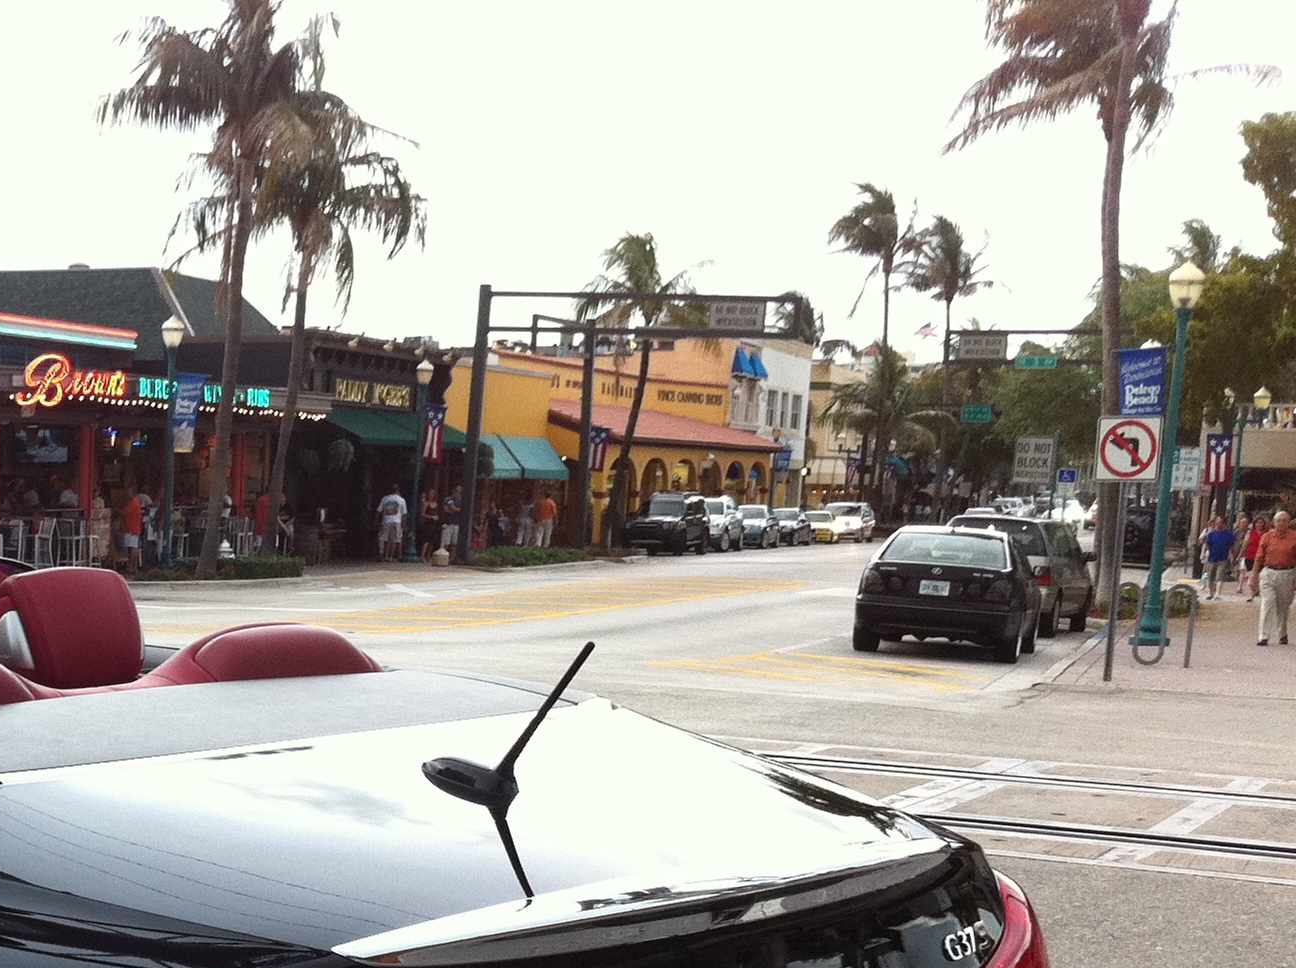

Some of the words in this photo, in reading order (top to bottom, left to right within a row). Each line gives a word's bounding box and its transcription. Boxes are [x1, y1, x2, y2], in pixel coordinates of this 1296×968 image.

[246, 387, 271, 408] RIBS
[1124, 383, 1162, 402] Delray
[1124, 394, 1159, 409] Beach
[1017, 443, 1030, 453] DO
[1033, 443, 1052, 454] NOT
[1017, 456, 1050, 468] BLOCK
